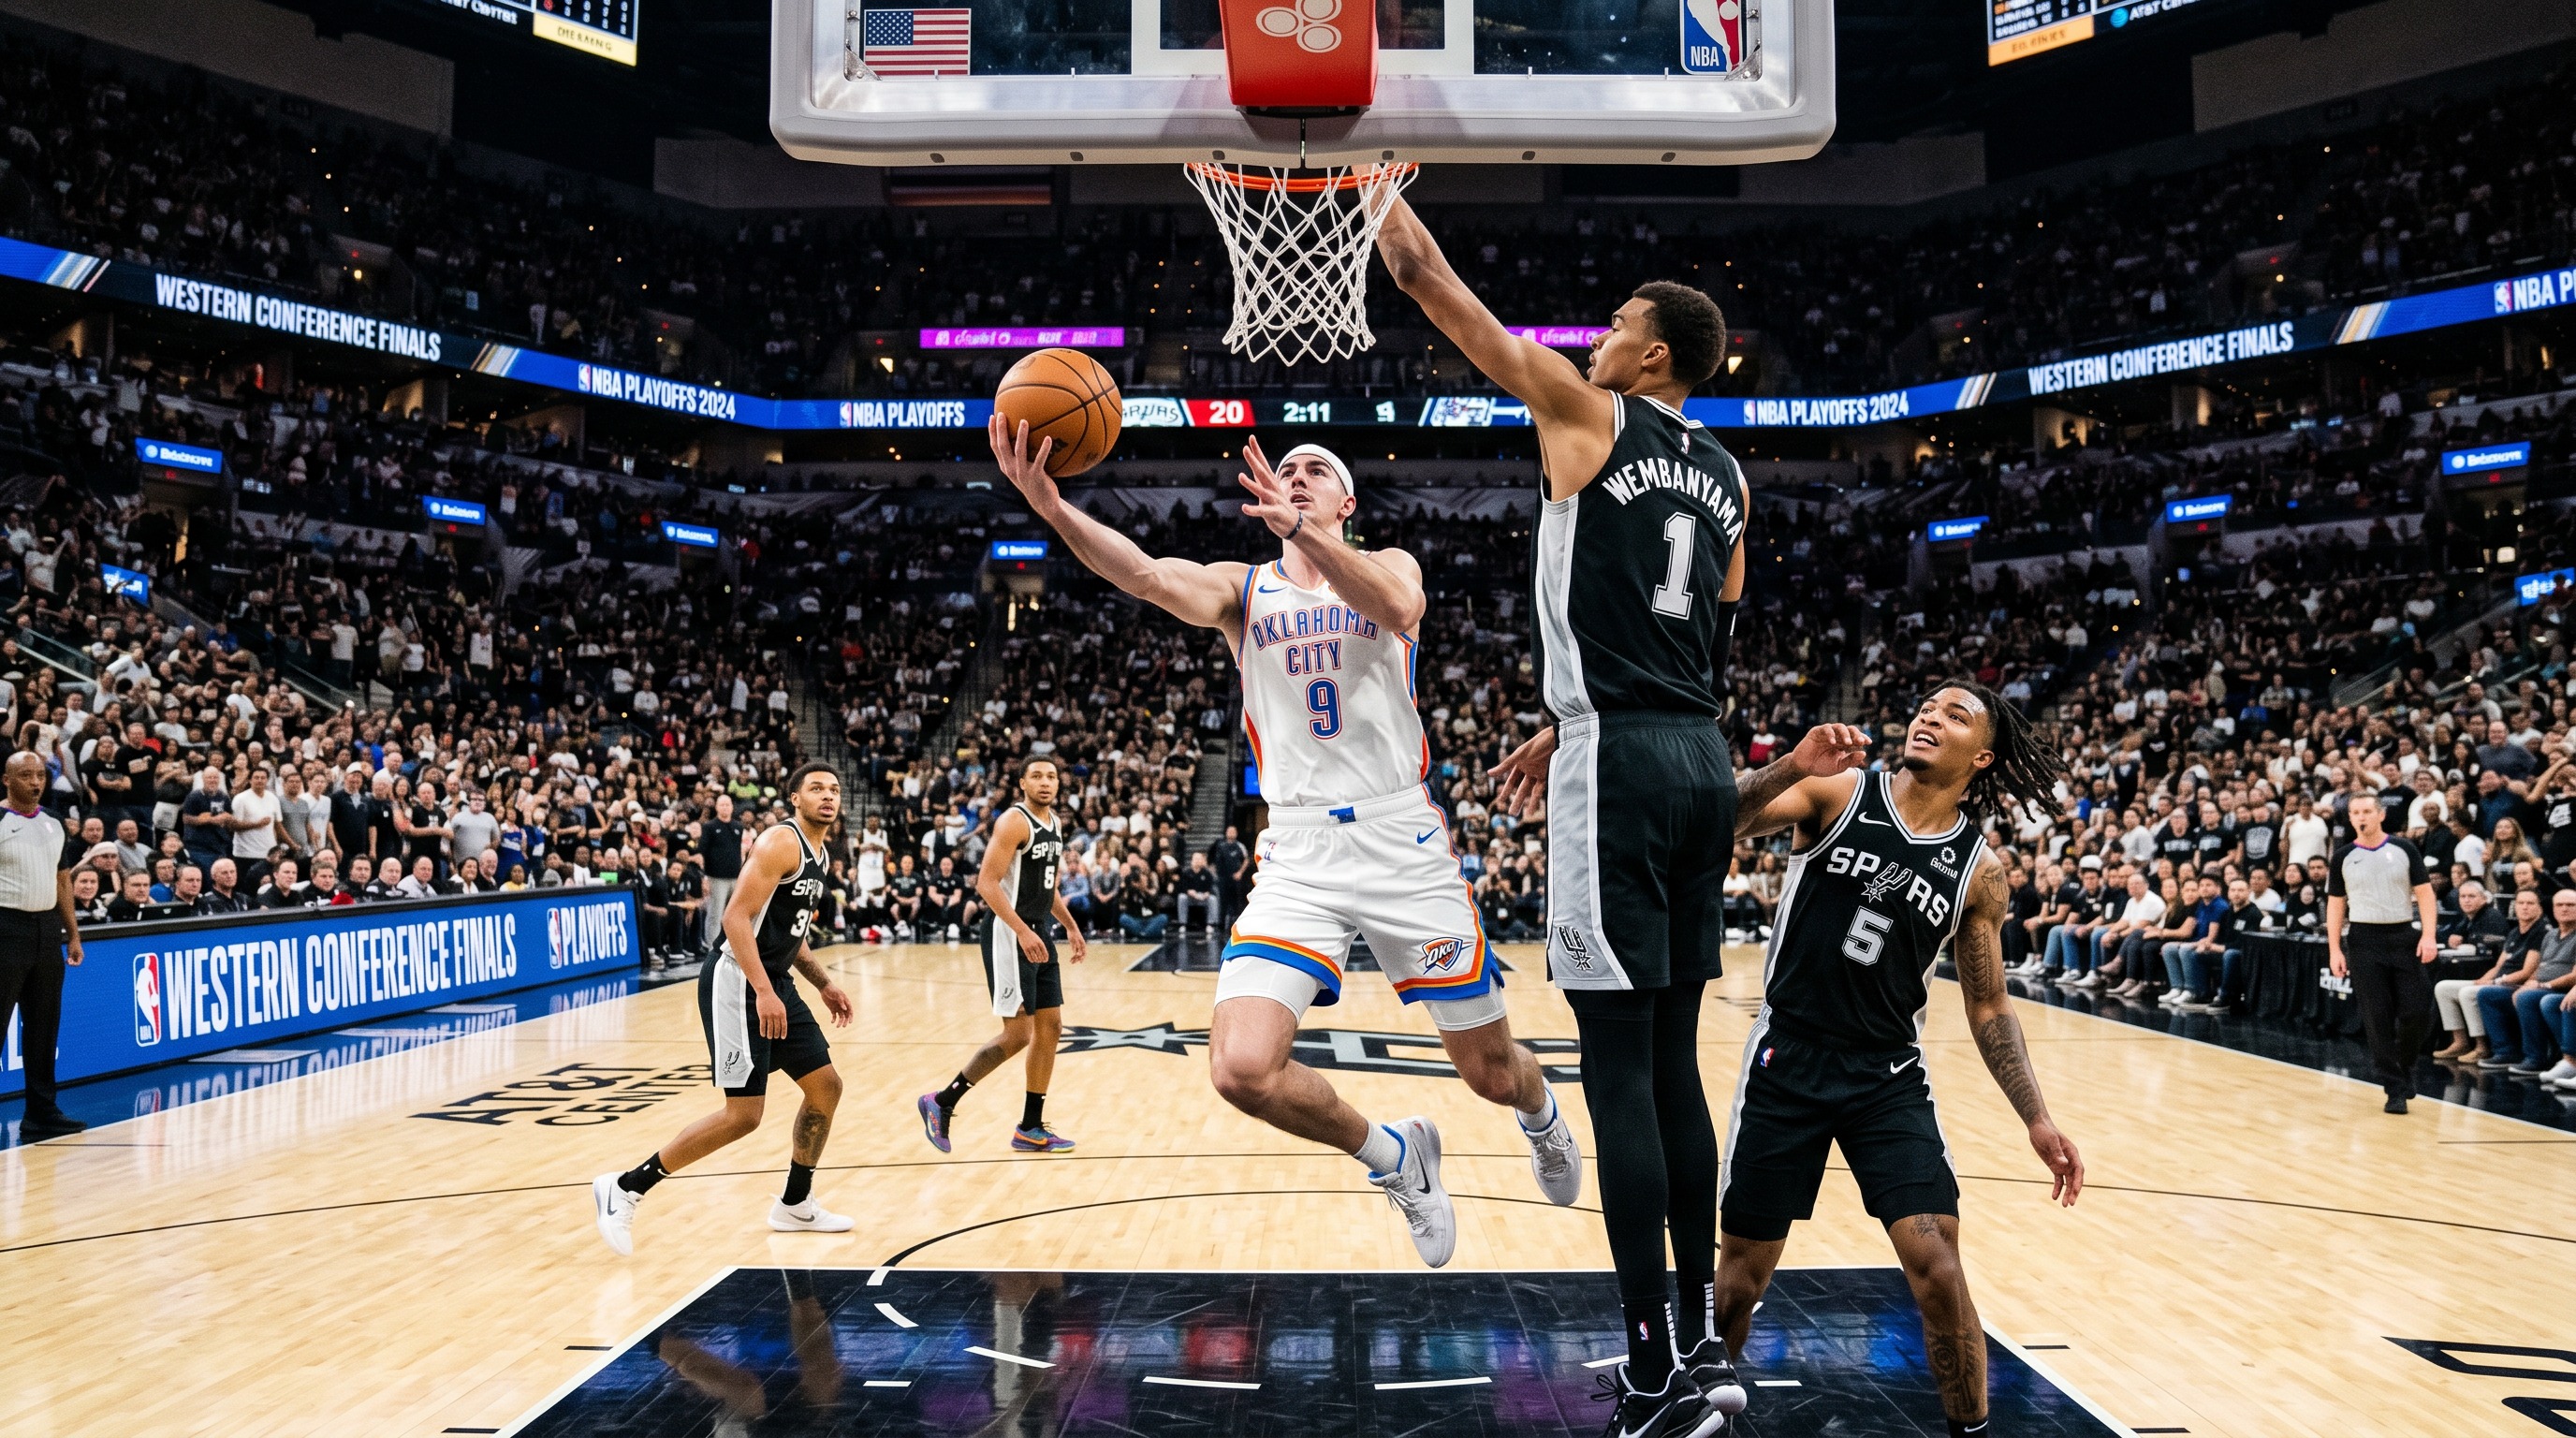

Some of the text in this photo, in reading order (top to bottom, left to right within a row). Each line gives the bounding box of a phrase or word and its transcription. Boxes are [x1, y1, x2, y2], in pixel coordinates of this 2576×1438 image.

[1690, 46, 1720, 66] NBA
[155, 273, 441, 362] WESTERN CONFERENCE FINALS
[2512, 274, 2556, 311] NBA
[2028, 321, 2294, 395] WESTERN CONFERENCE FINALS
[592, 366, 736, 419] NBA PLAYOFFS 2024
[853, 401, 965, 427] NBA PLAYOFFS
[1208, 401, 1244, 424] 20
[1283, 402, 1330, 422] 2:11
[1757, 390, 1909, 425] NBA PLAYOFFS 2024
[1602, 458, 1743, 546] WEMBANYAMA
[1652, 511, 1696, 620] 1
[1251, 605, 1379, 651] OKLAHOMA
[1285, 638, 1341, 676] CITY
[1306, 677, 1342, 740] 9
[1826, 846, 1950, 927] SPURS
[1841, 905, 1894, 966] 5
[164, 901, 627, 1040] WESTERN CONFERENCE FINALS PLAYOFFS
[406, 1063, 658, 1125] AT&T
